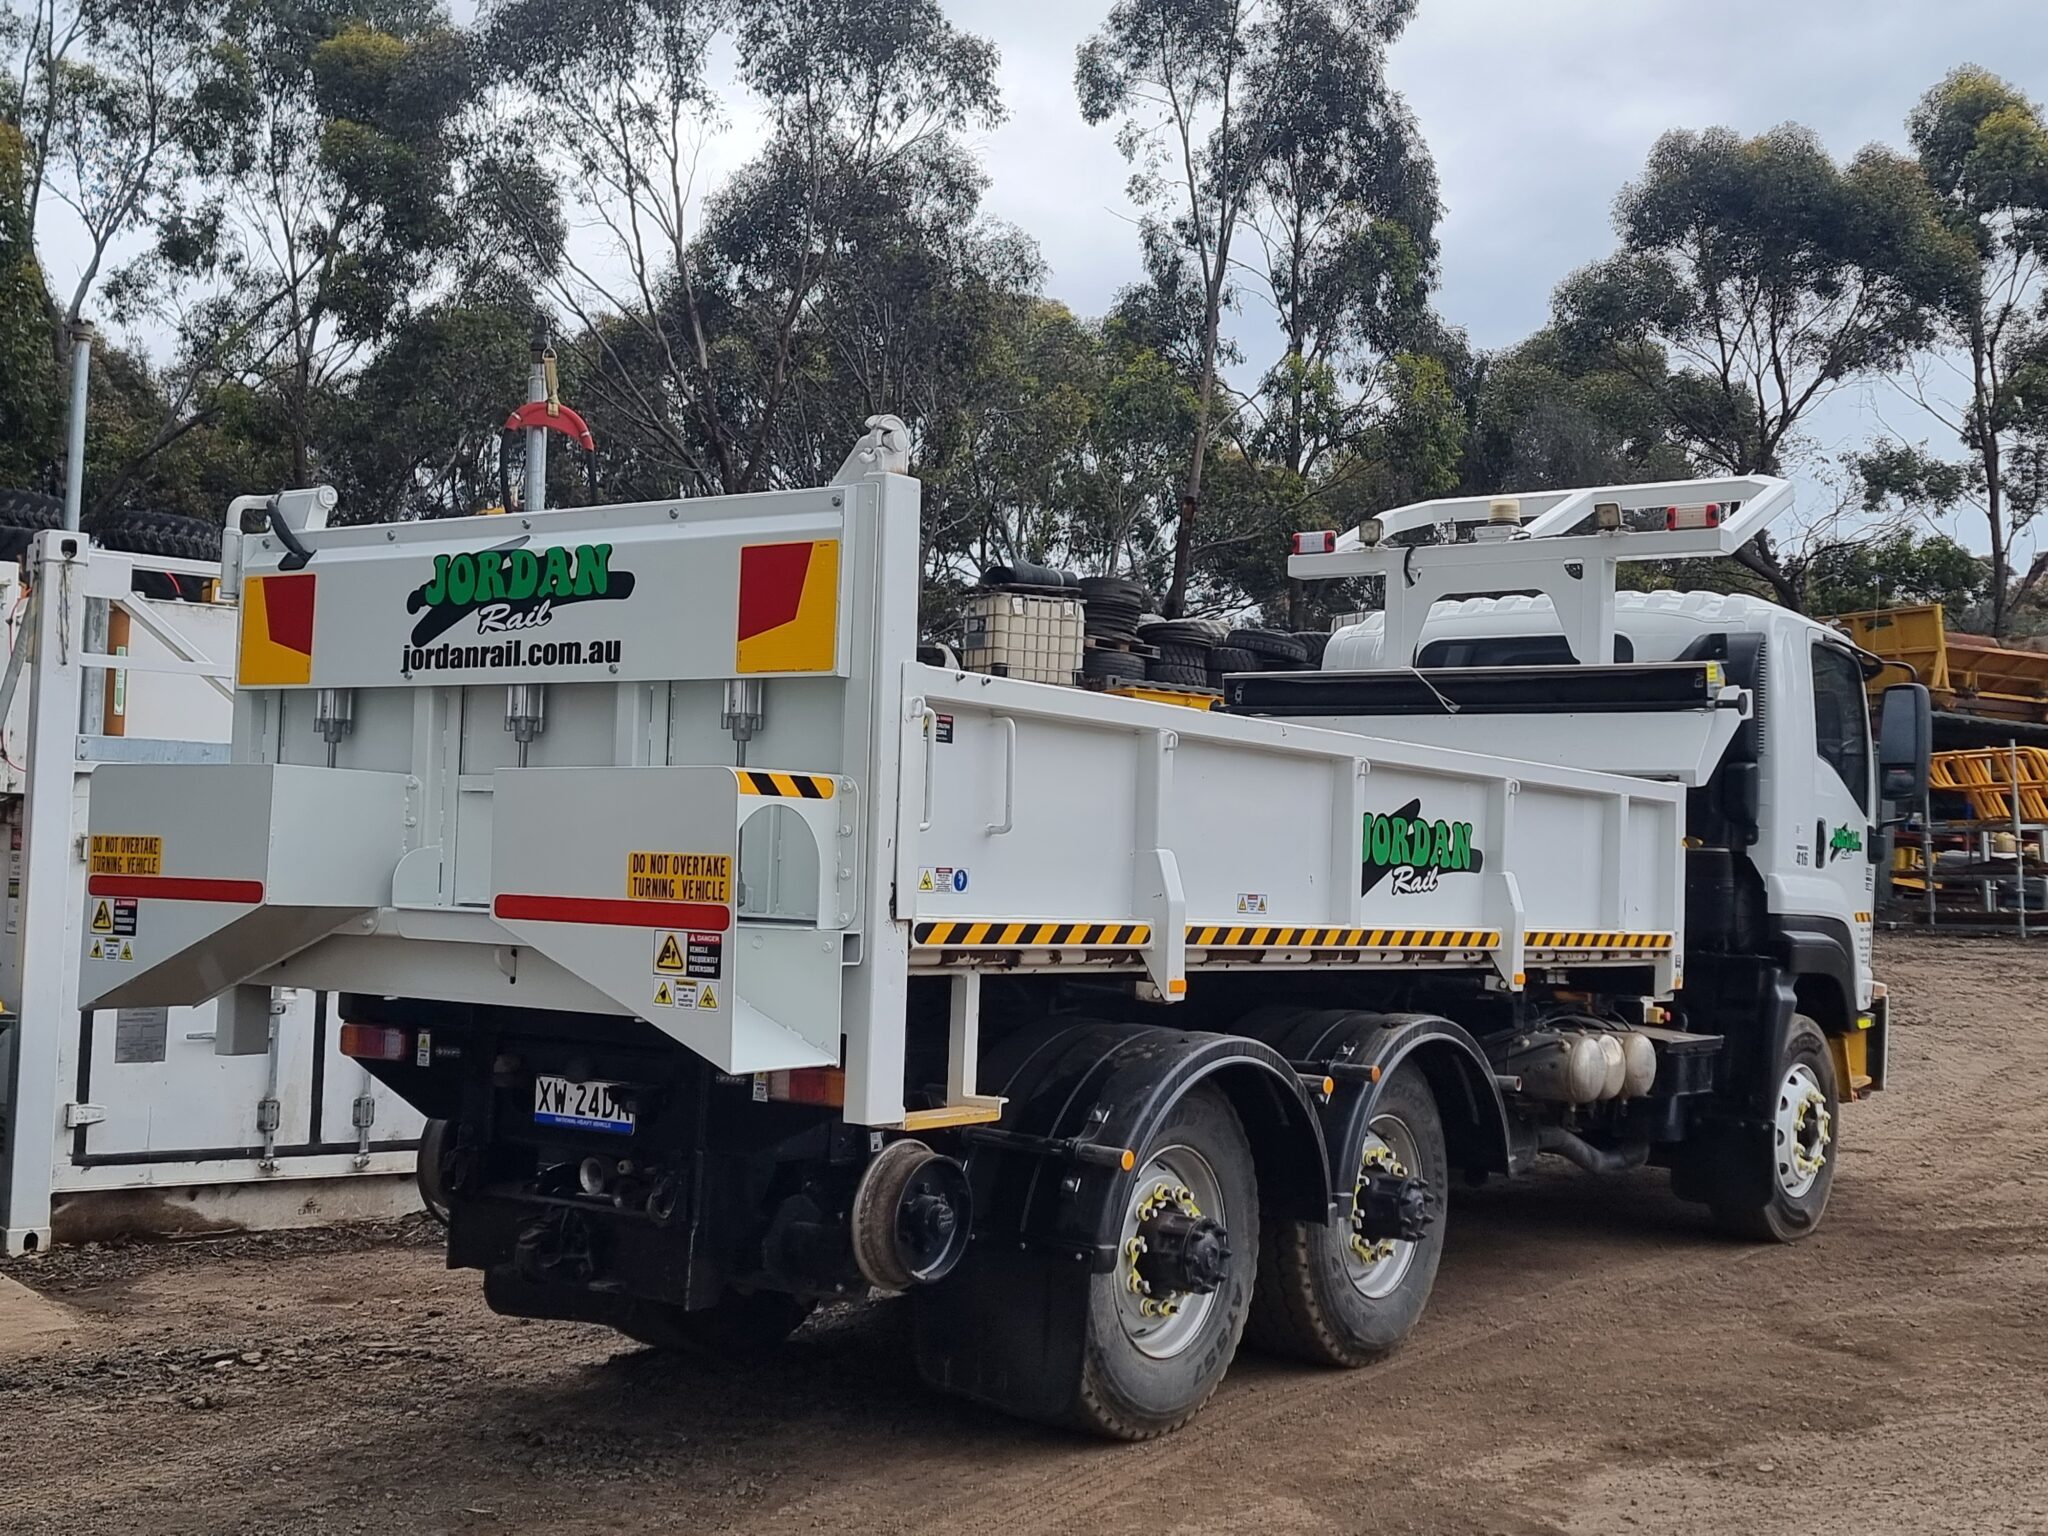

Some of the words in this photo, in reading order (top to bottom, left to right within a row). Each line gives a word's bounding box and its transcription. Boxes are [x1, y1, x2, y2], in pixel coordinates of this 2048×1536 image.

[425, 544, 612, 606] JORDAN
[478, 600, 551, 633] Rail
[400, 640, 621, 673] jordanrail.com.au
[93, 836, 103, 853] DO
[105, 836, 119, 853] NOT
[121, 837, 158, 855] OVERTAKE
[93, 856, 122, 873] TURNING
[127, 857, 156, 874] VEHICLE
[633, 854, 646, 873] DO
[650, 855, 669, 874] NOT
[673, 856, 726, 877] OVERTAKE
[633, 877, 675, 898] TURNING
[682, 880, 724, 901] VEHICLE
[1392, 865, 1439, 895] Rail
[689, 946, 708, 954] VEHICLE
[689, 955, 718, 964] FREQUENTLY
[689, 965, 715, 974] REVERSING
